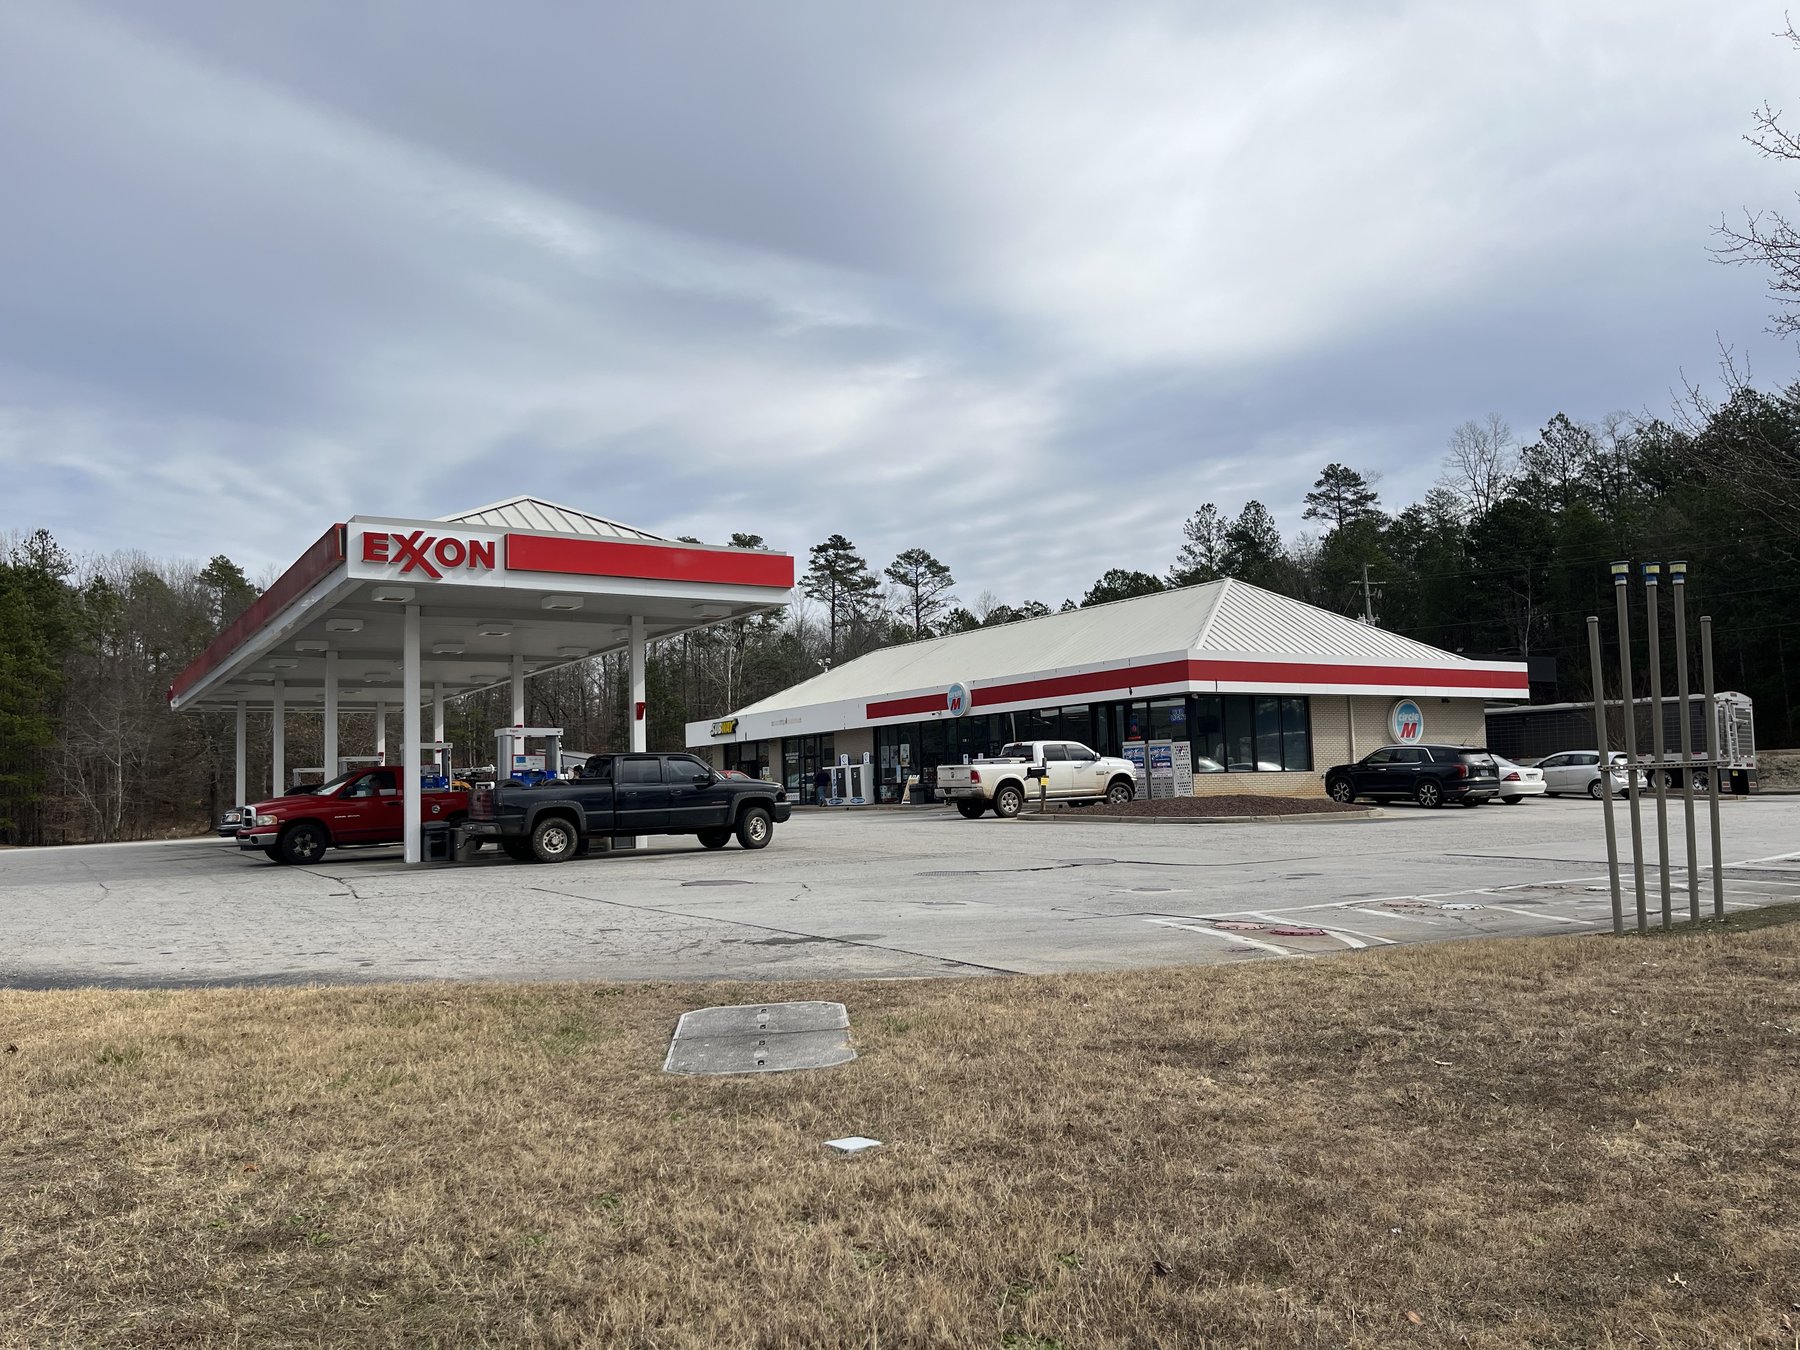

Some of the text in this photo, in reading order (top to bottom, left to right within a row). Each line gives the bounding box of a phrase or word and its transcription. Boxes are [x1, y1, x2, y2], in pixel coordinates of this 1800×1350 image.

[362, 530, 496, 580] EXXON
[950, 697, 962, 711] M
[1398, 712, 1420, 722] circle
[710, 719, 738, 736] SUBWAY
[1400, 722, 1419, 738] M
